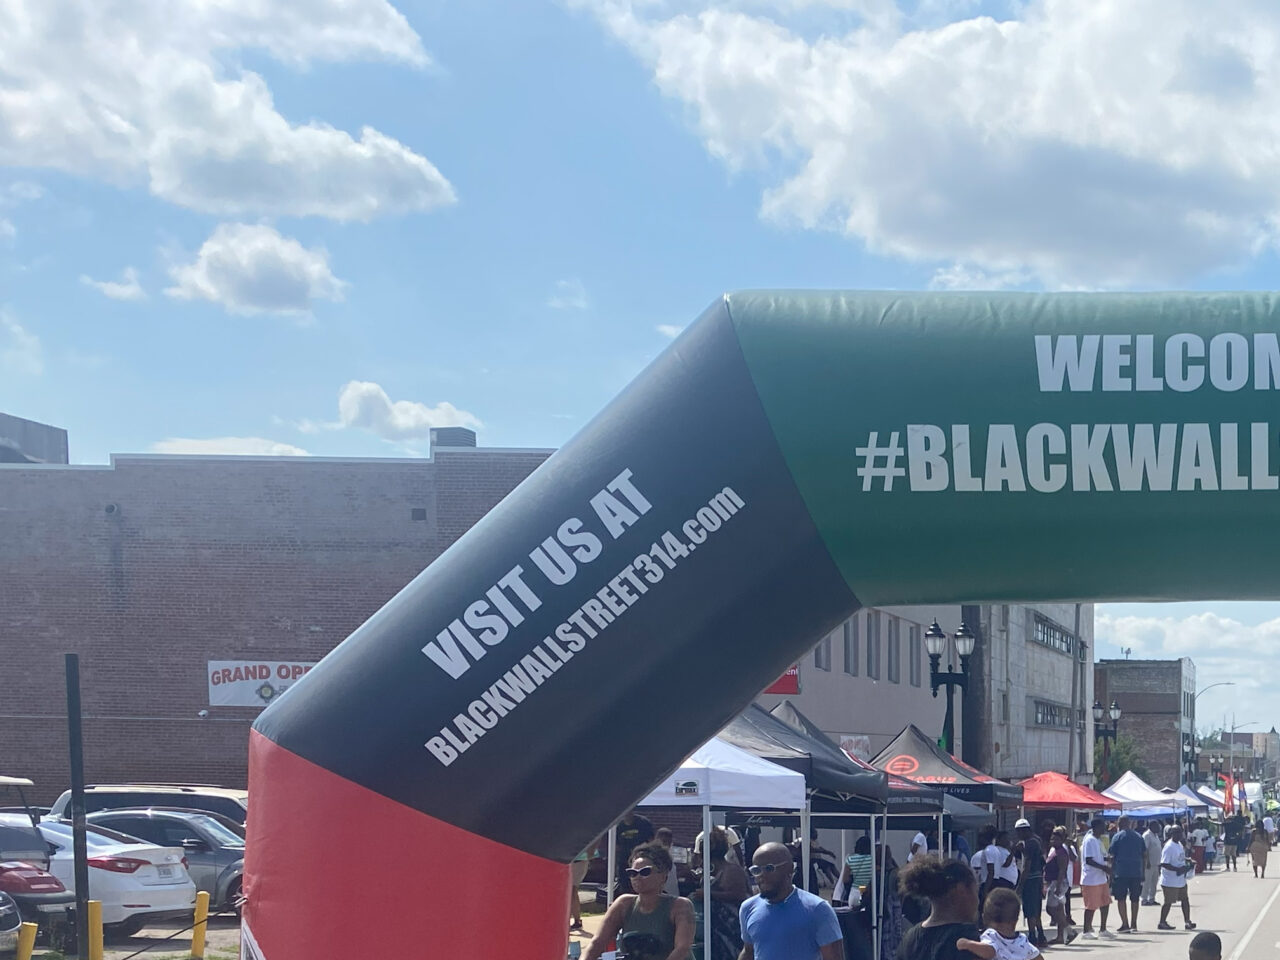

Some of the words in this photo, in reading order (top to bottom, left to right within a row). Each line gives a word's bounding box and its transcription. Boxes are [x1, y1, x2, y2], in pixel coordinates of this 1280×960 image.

[211, 664, 271, 686] GRAND
[420, 564, 544, 681] VISIT
[528, 517, 604, 586] US
[588, 467, 653, 540] AT
[423, 486, 747, 768] BLACKWALLSTREET314.com
